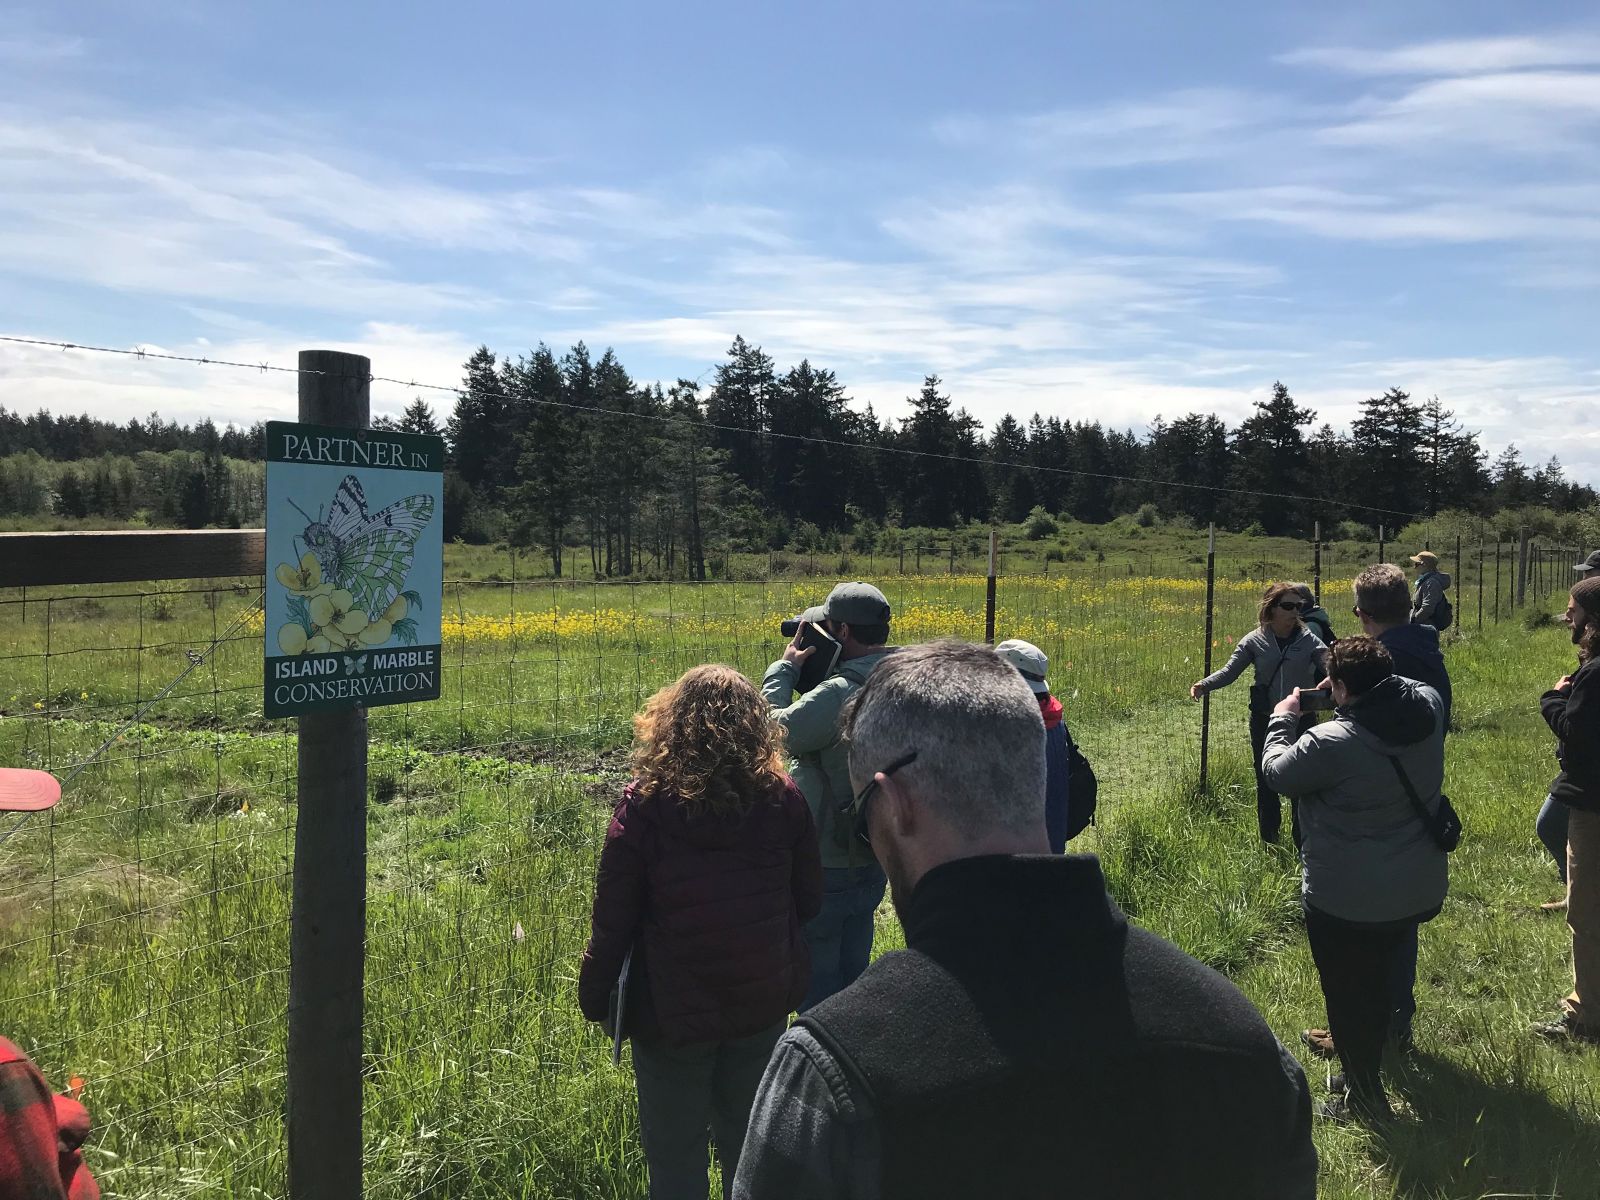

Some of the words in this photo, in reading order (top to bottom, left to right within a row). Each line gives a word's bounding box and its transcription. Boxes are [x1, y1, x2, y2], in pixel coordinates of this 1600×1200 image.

[282, 434, 407, 467] PARTNER
[410, 452, 429, 468] IN
[275, 658, 338, 679] ISLAND
[373, 650, 434, 670] MARBLE
[274, 671, 434, 705] CONSERVATION
